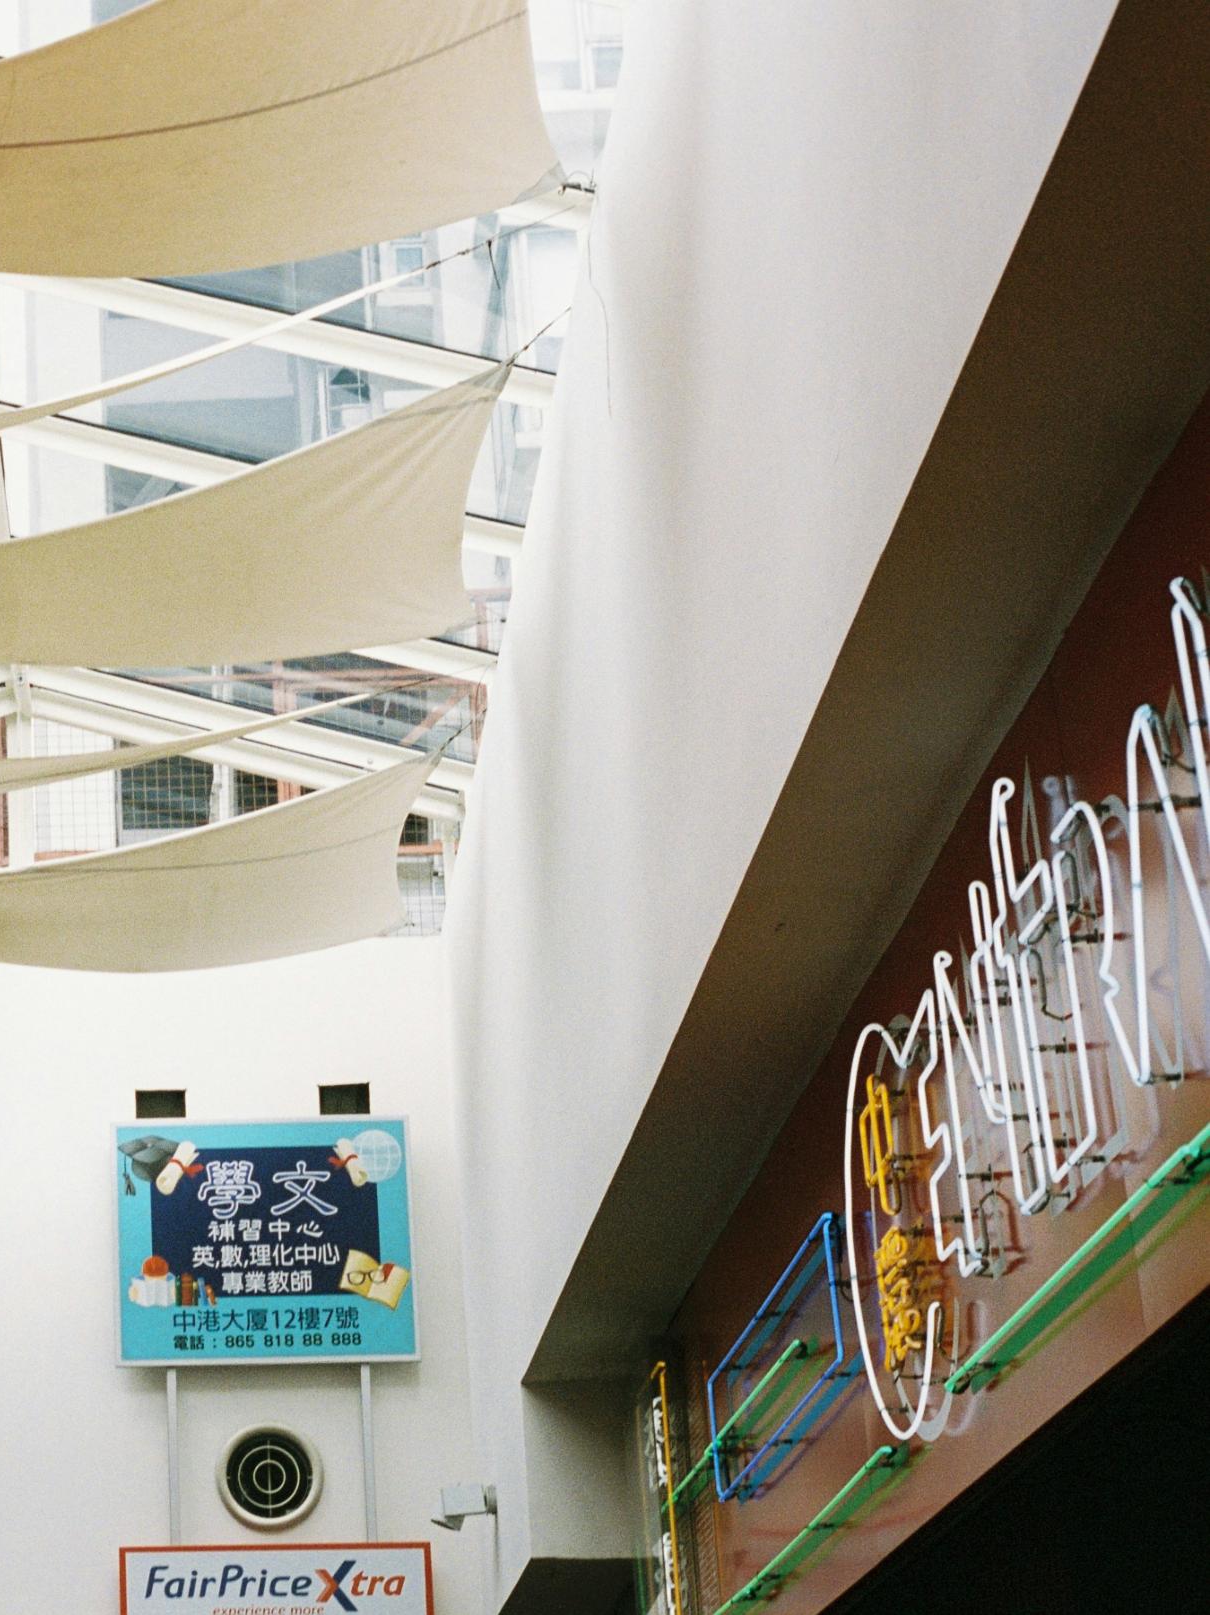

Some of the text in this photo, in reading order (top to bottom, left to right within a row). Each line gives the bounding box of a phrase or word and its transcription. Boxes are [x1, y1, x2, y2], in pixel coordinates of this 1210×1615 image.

[197, 1160, 339, 1220] 學文
[208, 1218, 324, 1243] 補習中心
[221, 1270, 313, 1295] 專業教師
[224, 1334, 255, 1348] 865
[264, 1334, 294, 1347] 818
[302, 1333, 323, 1347] 88
[331, 1332, 362, 1346] 888
